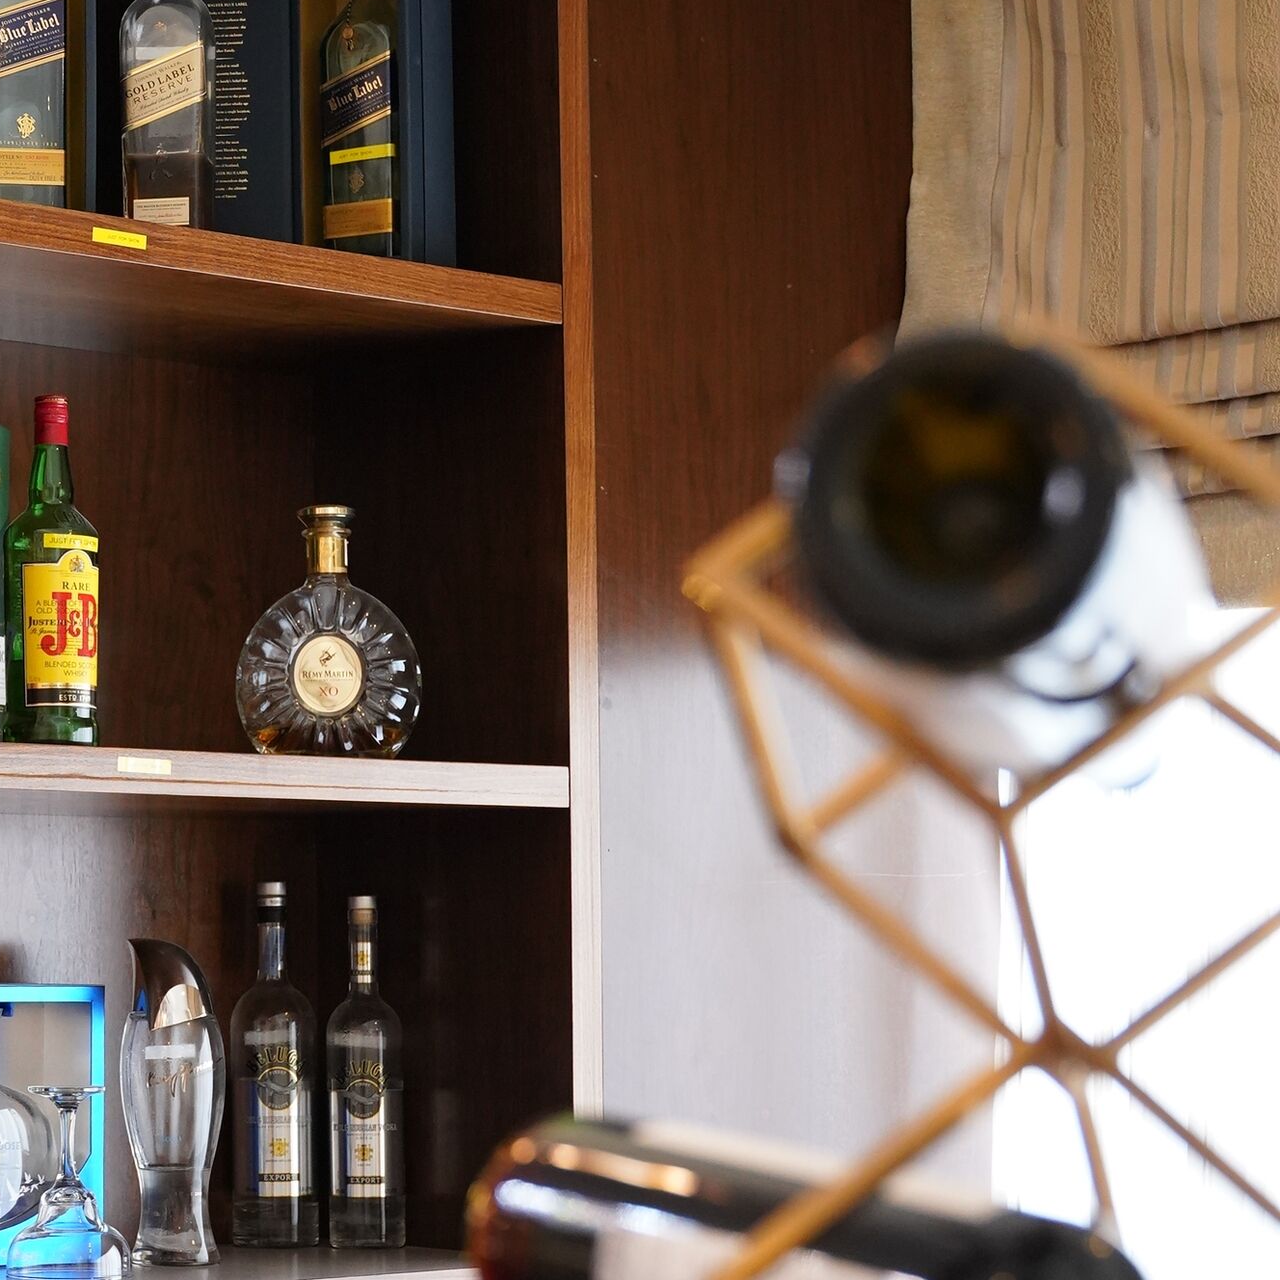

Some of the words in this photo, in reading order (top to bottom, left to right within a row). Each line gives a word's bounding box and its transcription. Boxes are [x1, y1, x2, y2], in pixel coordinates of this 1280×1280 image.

[25, 13, 60, 36] Label
[125, 80, 156, 99] GOLD
[157, 64, 195, 85] LABEL
[133, 75, 193, 104] RESERVE
[328, 91, 354, 112] Blue
[351, 75, 383, 98] Label
[62, 581, 90, 591] RARE
[44, 660, 77, 668] BLENDED
[324, 670, 353, 678] MARTIN
[319, 686, 338, 697] XO
